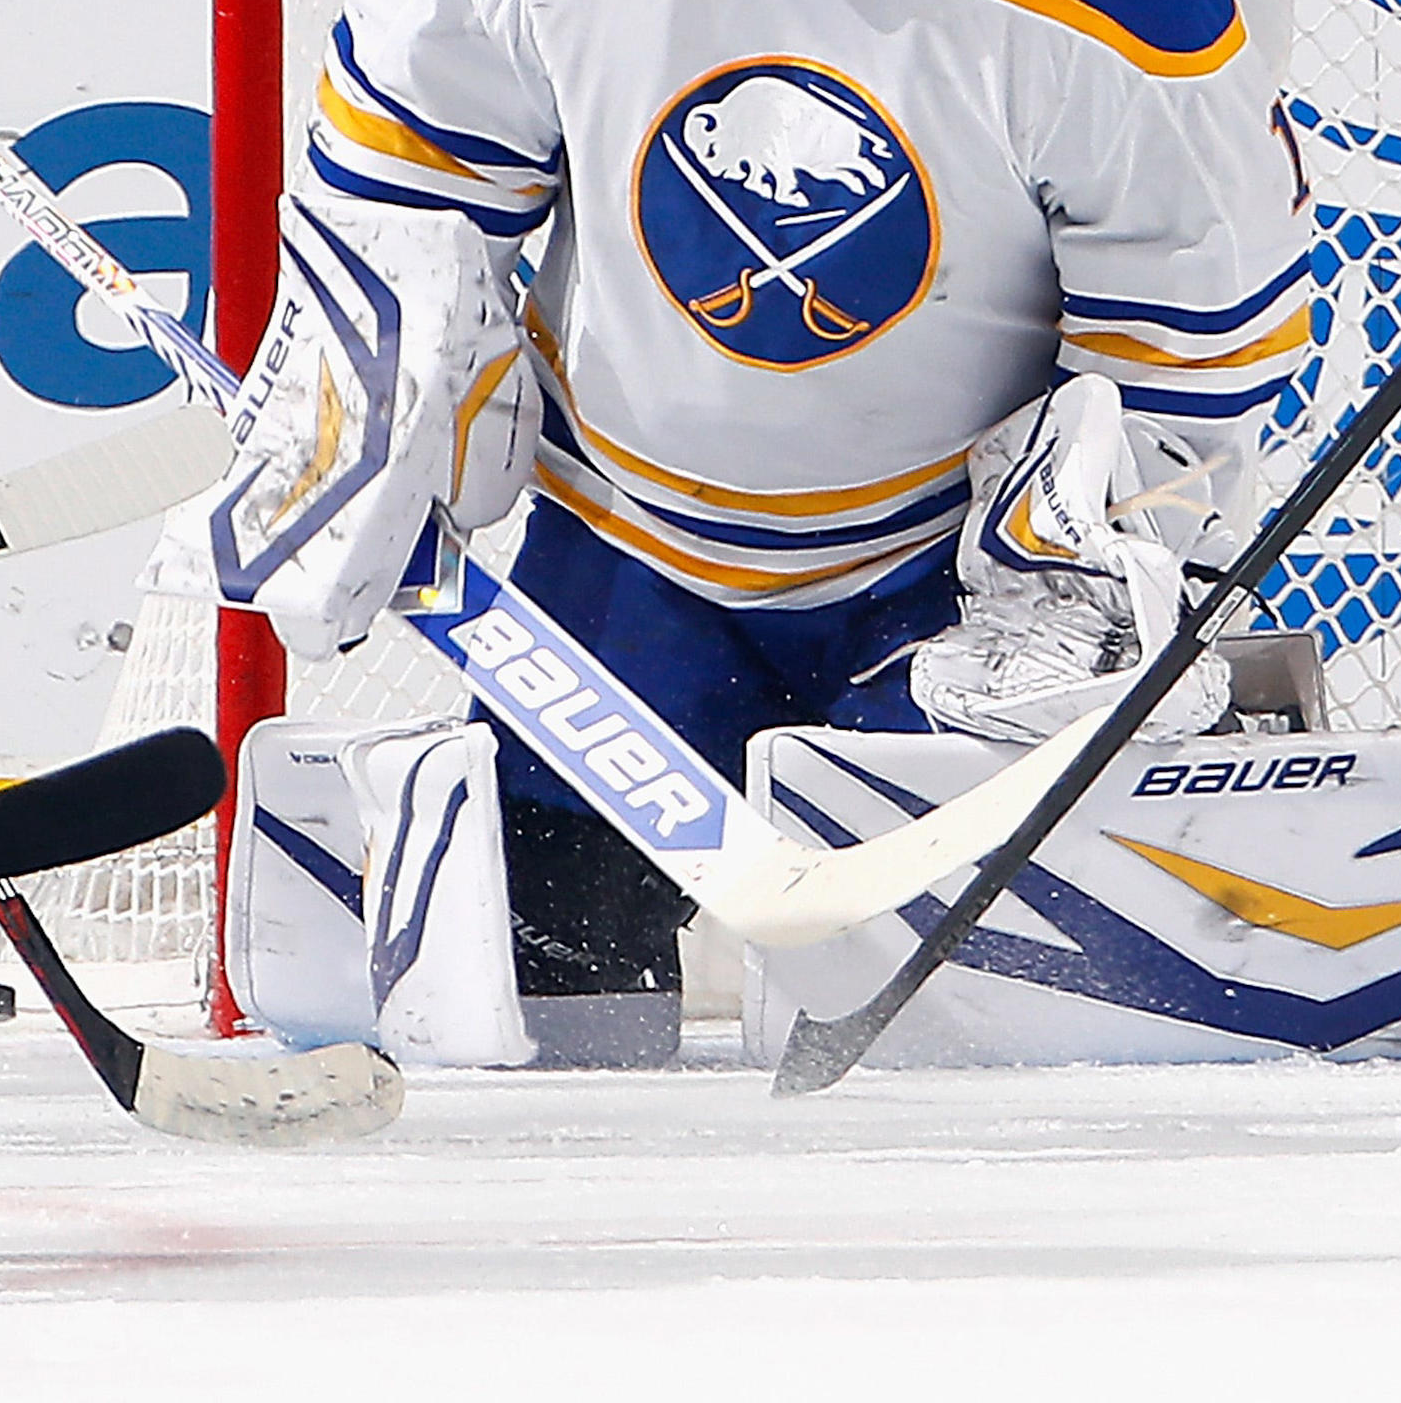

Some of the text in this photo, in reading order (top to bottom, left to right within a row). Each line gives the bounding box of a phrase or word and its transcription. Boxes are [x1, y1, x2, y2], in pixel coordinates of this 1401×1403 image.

[230, 297, 303, 447] AUER
[1039, 460, 1083, 545] BAUER
[448, 604, 712, 842] BAUER
[1130, 753, 1358, 798] BAUER
